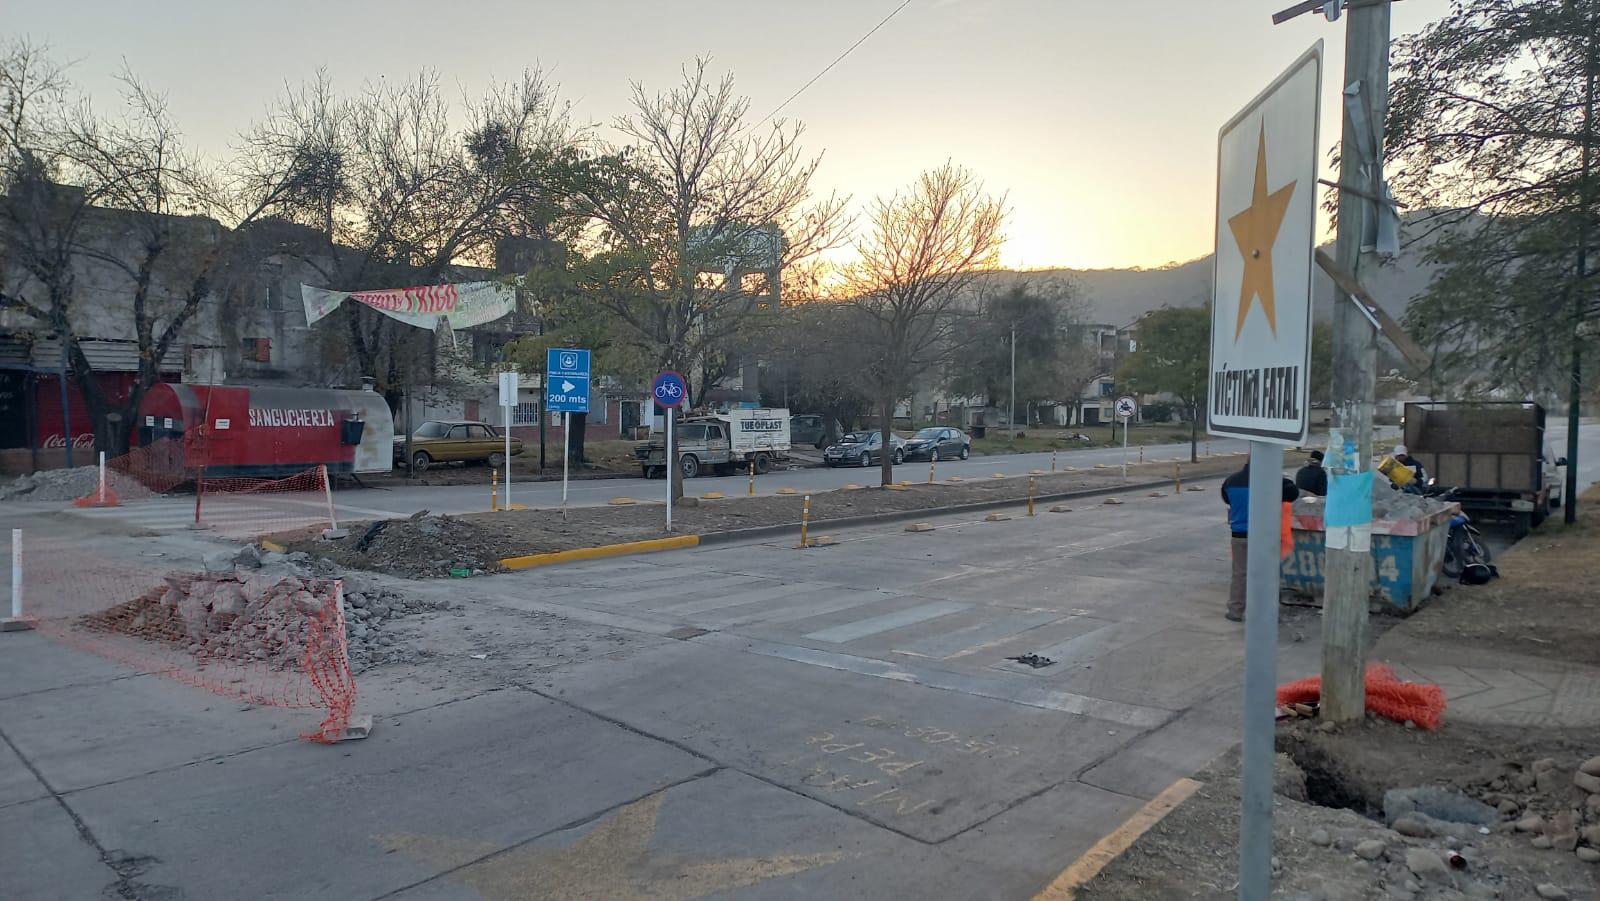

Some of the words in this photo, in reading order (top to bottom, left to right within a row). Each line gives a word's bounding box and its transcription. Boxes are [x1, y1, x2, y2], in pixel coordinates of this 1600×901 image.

[401, 284, 458, 313] TRIGO
[549, 394, 566, 403] 200
[568, 396, 587, 404] mts
[1214, 362, 1260, 417] VÍCTIMA
[1262, 366, 1299, 420] FATAL
[248, 408, 335, 427] SANGUCHERIA
